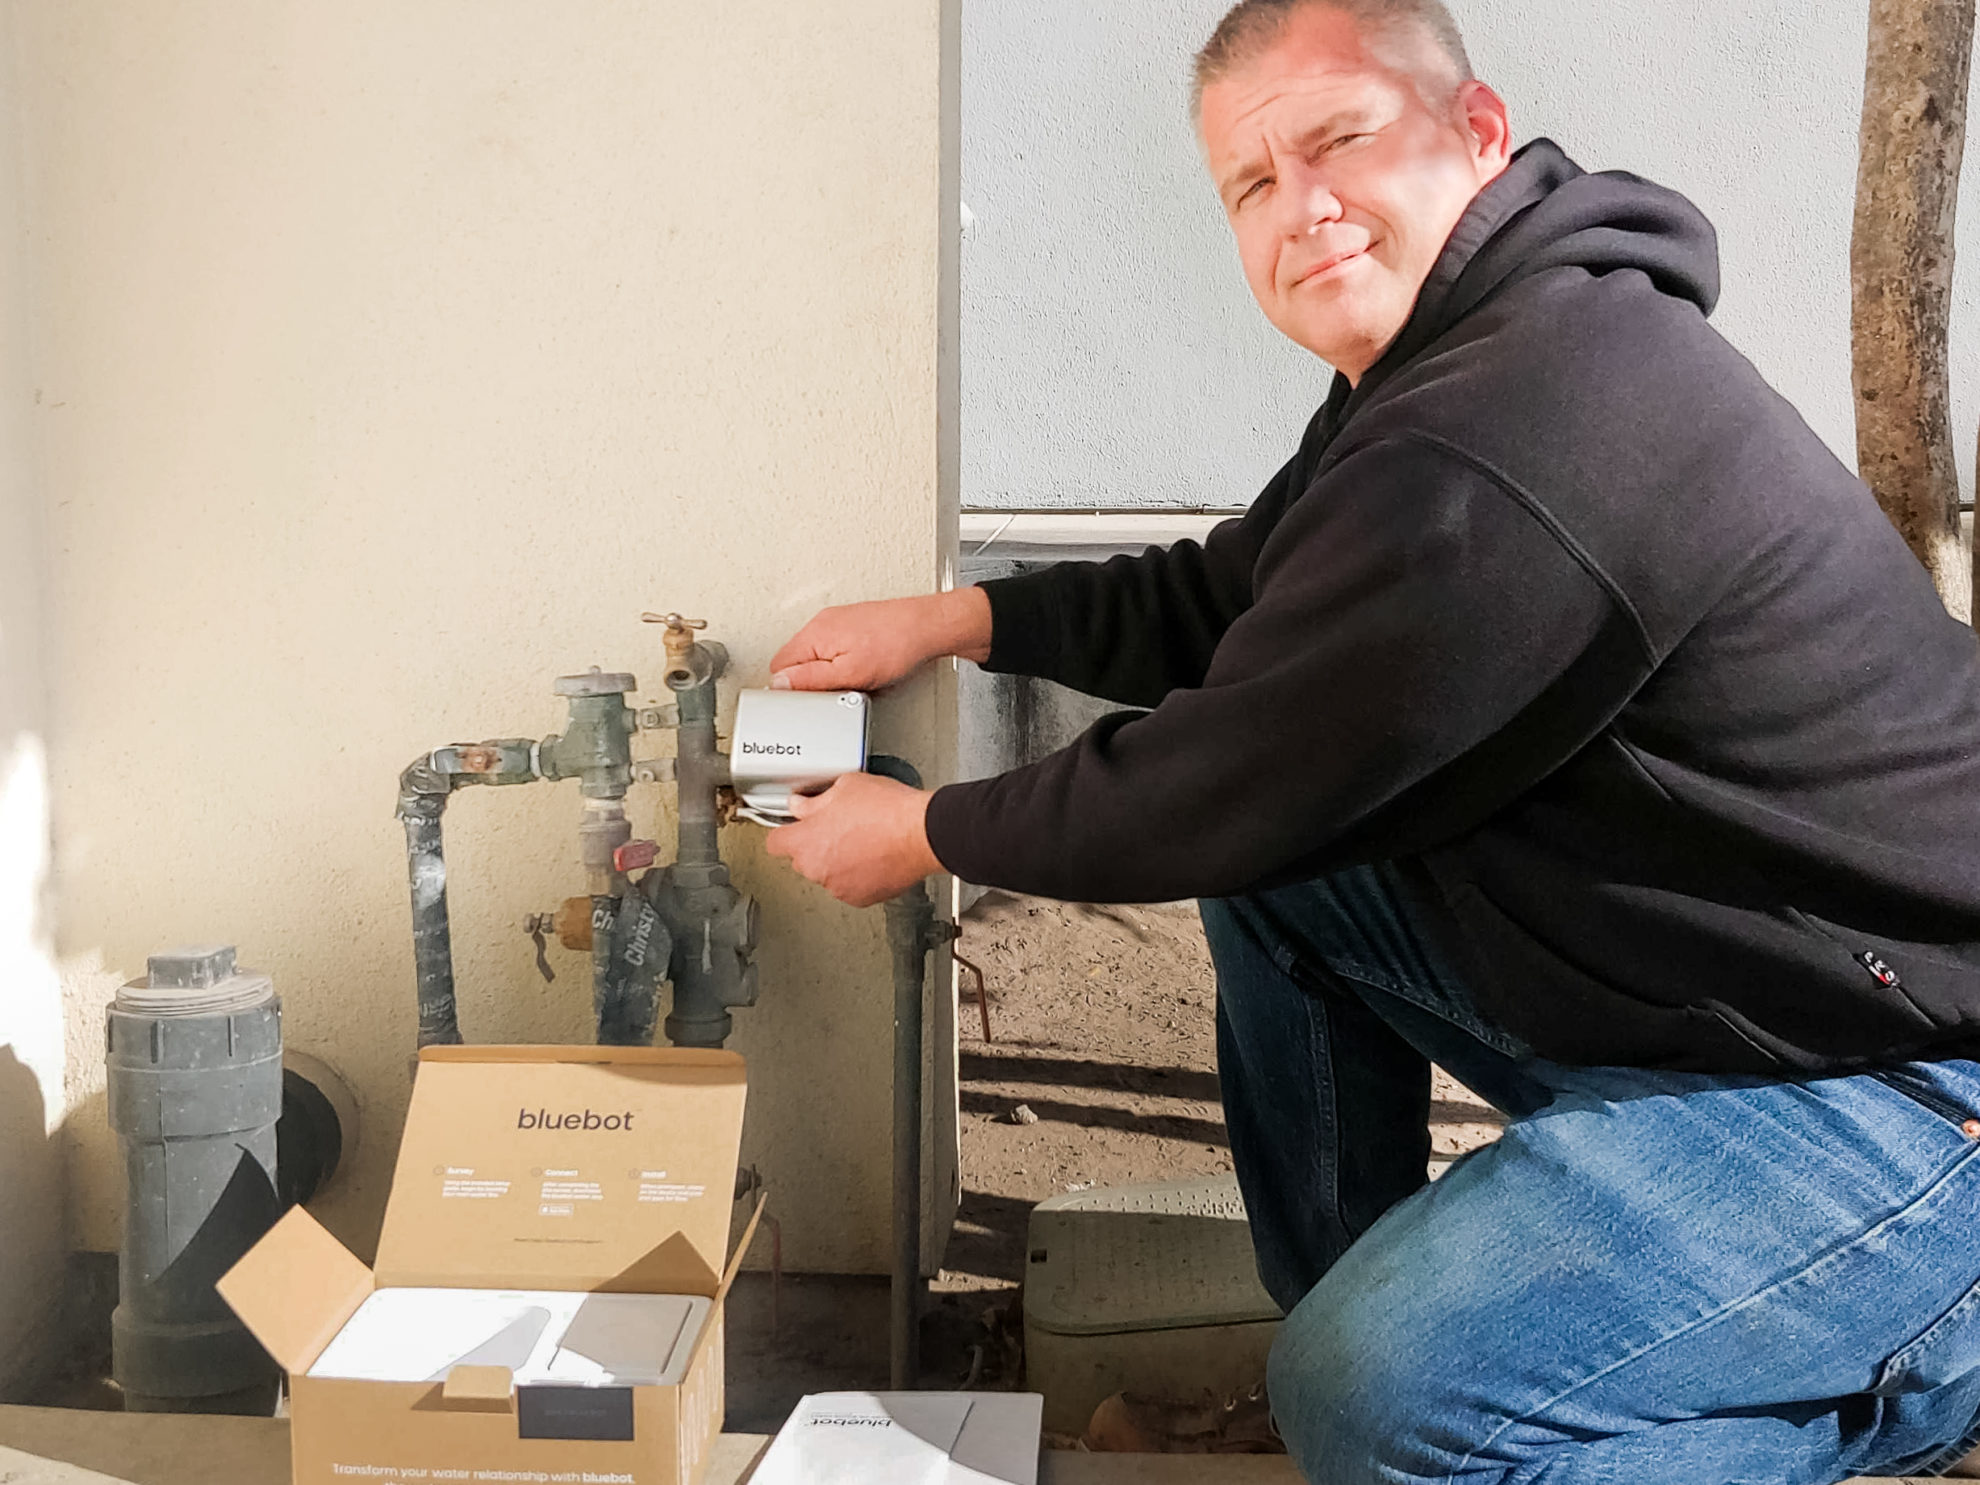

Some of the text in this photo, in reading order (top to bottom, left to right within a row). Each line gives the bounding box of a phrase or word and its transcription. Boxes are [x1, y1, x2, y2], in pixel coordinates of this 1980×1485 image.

[743, 742, 801, 756] bluebot
[517, 1108, 635, 1131] bluebot
[811, 1418, 892, 1427] bluebot
[333, 1463, 398, 1476] Transform
[400, 1467, 428, 1478] your
[431, 1468, 470, 1479] water
[473, 1469, 548, 1483] relationship
[550, 1472, 580, 1482] with
